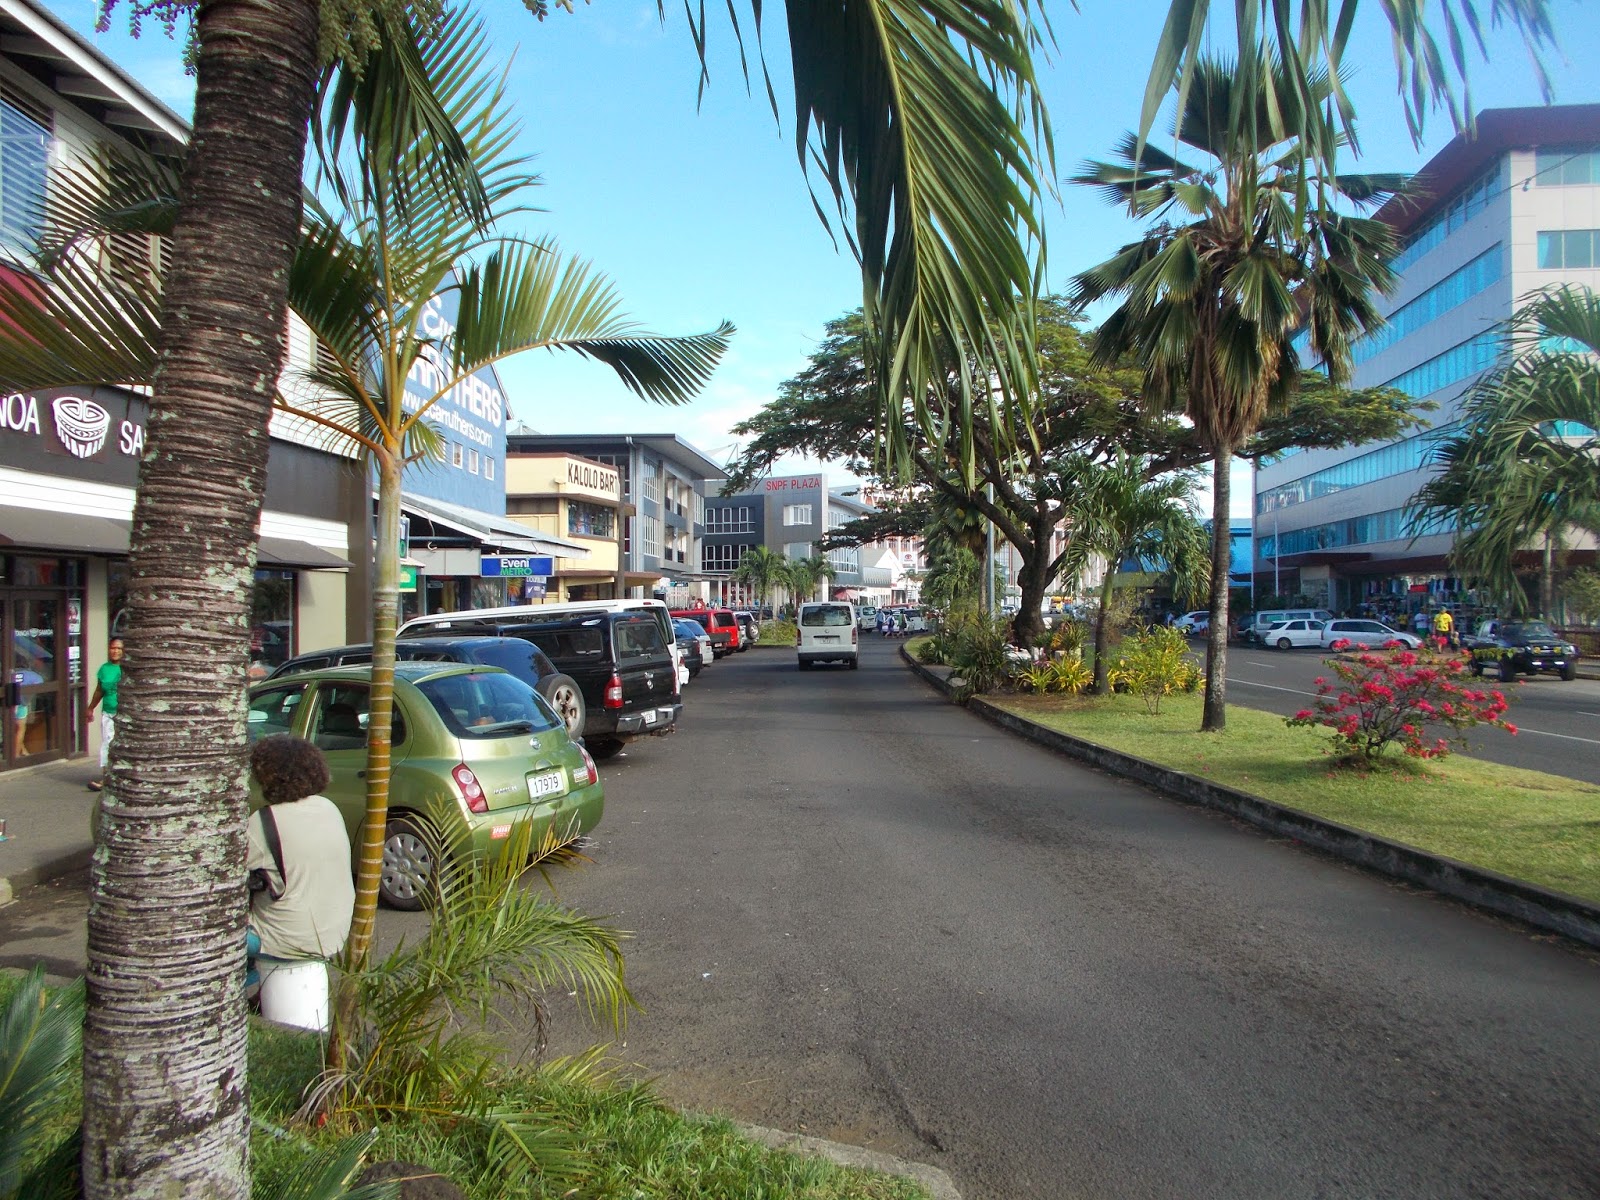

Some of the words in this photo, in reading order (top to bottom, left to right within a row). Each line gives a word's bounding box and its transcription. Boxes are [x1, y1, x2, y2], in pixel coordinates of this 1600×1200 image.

[568, 462, 598, 490] KALOLO
[766, 480, 788, 491] SNPF
[791, 478, 820, 490] PLAZA
[501, 556, 530, 568] Eveni
[501, 567, 532, 576] METRO
[534, 775, 559, 794] 17979
